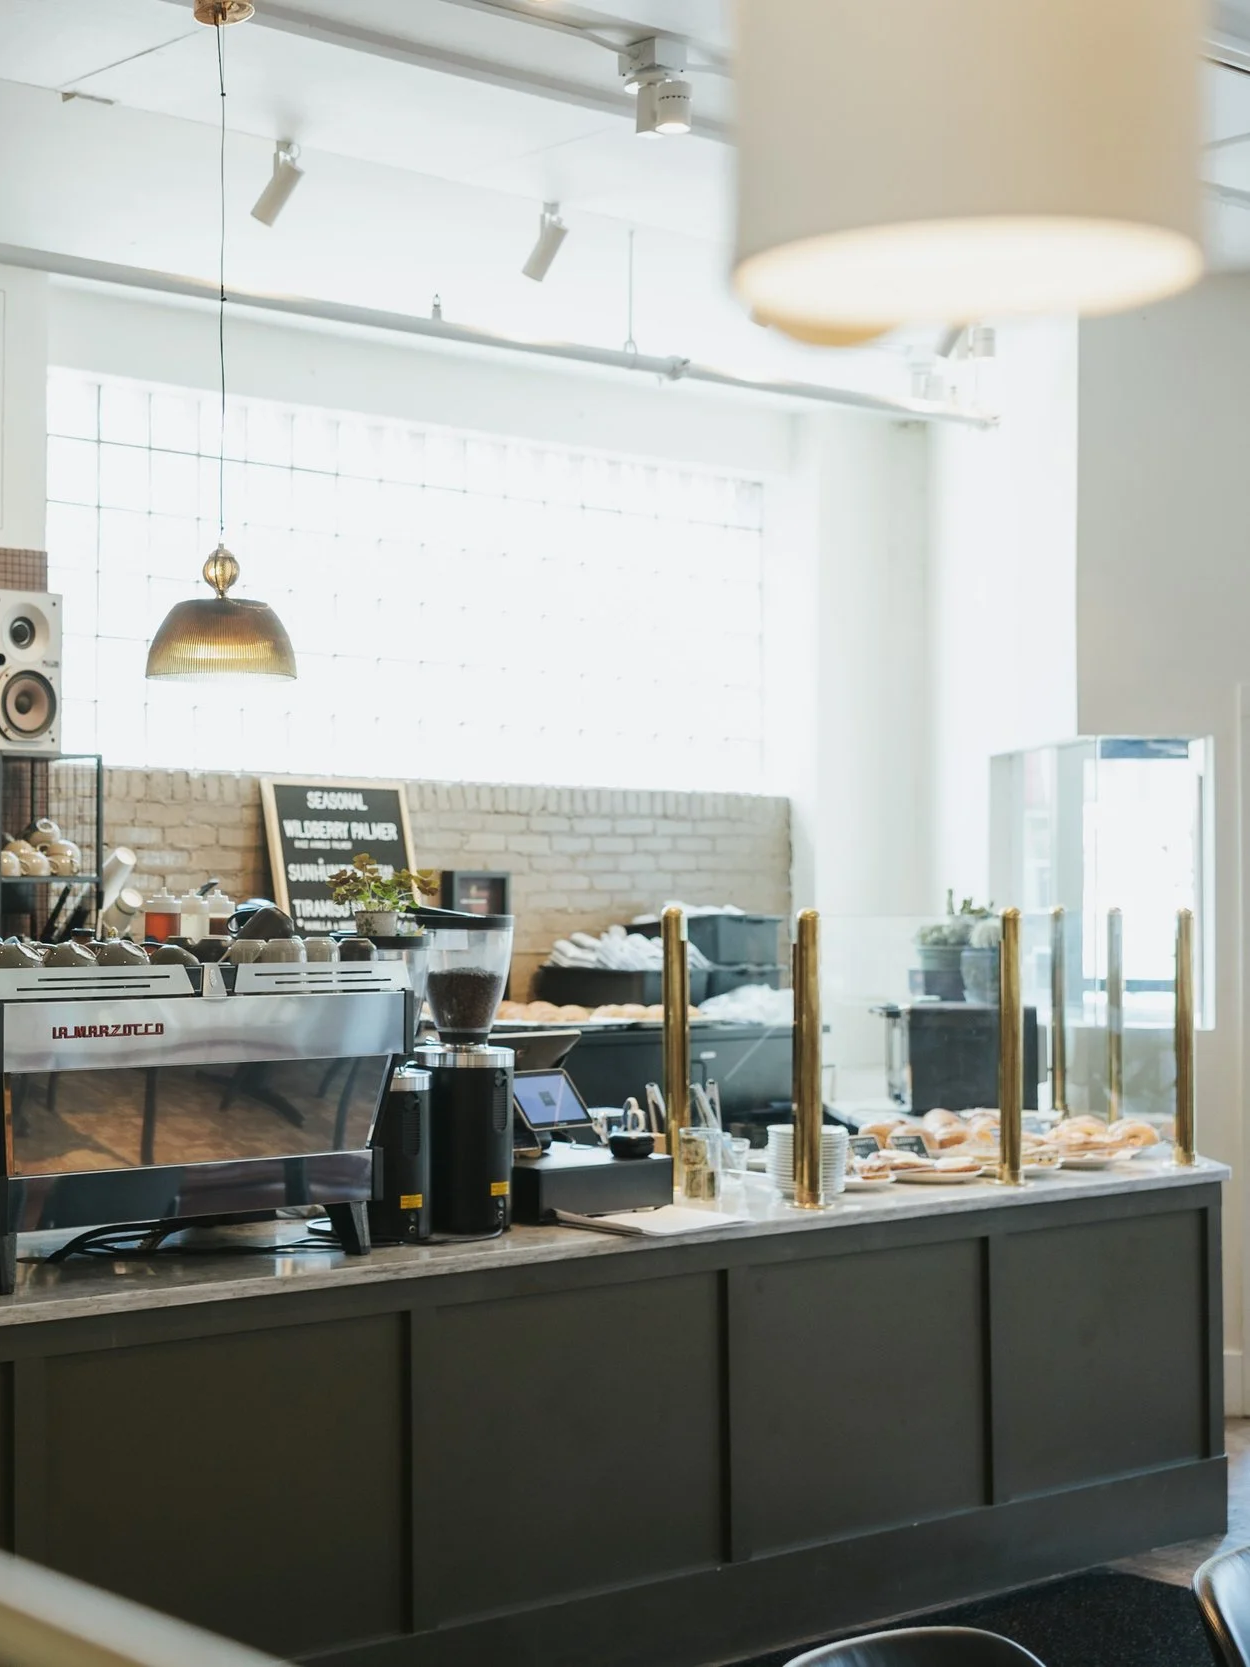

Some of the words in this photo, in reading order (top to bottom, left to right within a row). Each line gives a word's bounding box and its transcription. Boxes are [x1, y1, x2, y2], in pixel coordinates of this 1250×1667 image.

[306, 791, 369, 811] SEASONAL
[351, 822, 398, 841] PALMER
[73, 1023, 164, 1038] MARZOCCO
